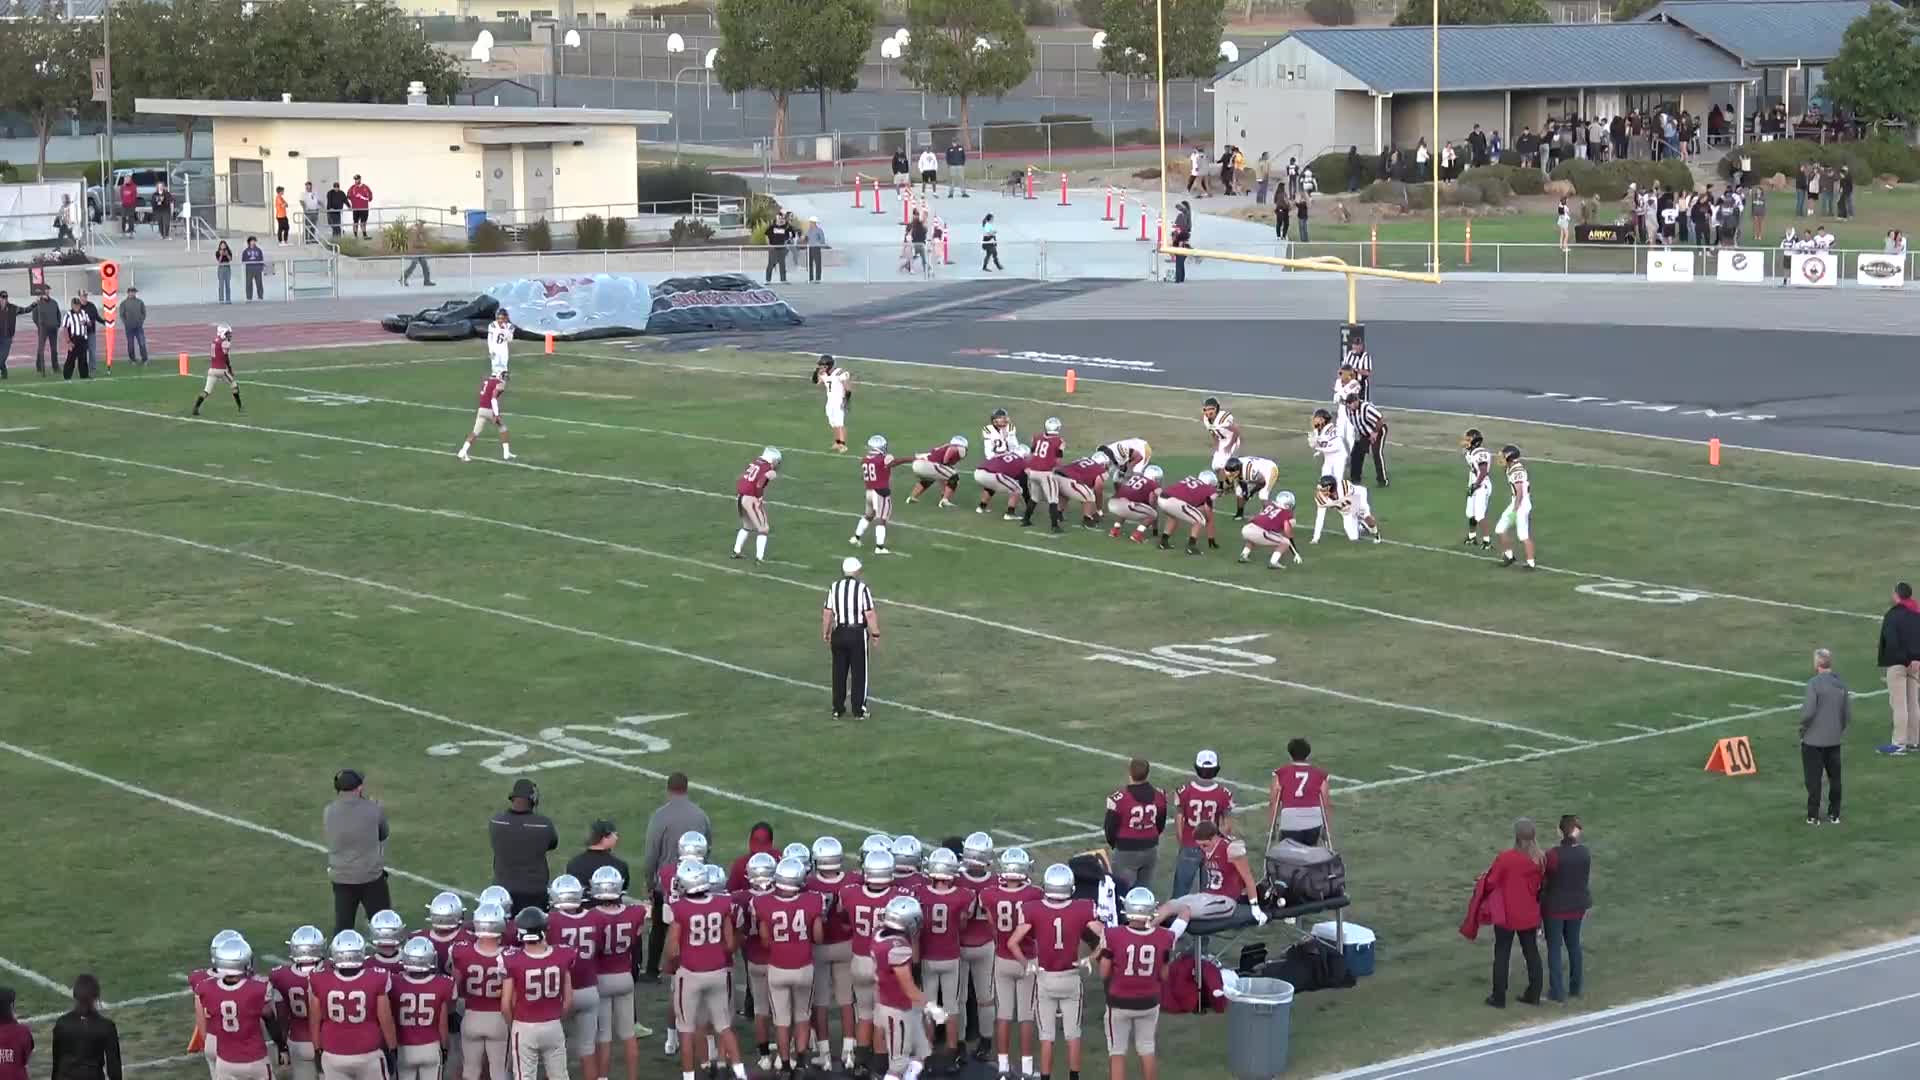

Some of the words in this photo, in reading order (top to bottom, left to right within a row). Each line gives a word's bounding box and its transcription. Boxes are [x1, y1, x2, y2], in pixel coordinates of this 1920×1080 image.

[1588, 230, 1612, 241] ARMY
[496, 333, 505, 345] 6
[826, 381, 833, 393] 7
[1034, 440, 1049, 458] 18
[861, 463, 877, 481] 28
[1126, 475, 1147, 490] 66
[1083, 644, 1277, 679] 10
[426, 724, 672, 775] 20
[1726, 739, 1751, 772] 10
[1295, 771, 1309, 798] 7
[1129, 804, 1158, 830] 23
[1188, 799, 1218, 828] 33
[689, 912, 722, 946] 88
[771, 909, 808, 942] 24
[931, 903, 948, 934] 9
[997, 901, 1025, 932] 81
[561, 926, 595, 960] 75
[603, 922, 632, 955] 15
[1053, 917, 1064, 950] 1
[1124, 944, 1156, 976] 19
[466, 964, 503, 998] 22
[525, 965, 561, 1001] 50
[220, 1000, 240, 1033] 8
[327, 990, 367, 1024] 63
[400, 993, 436, 1027] 25
